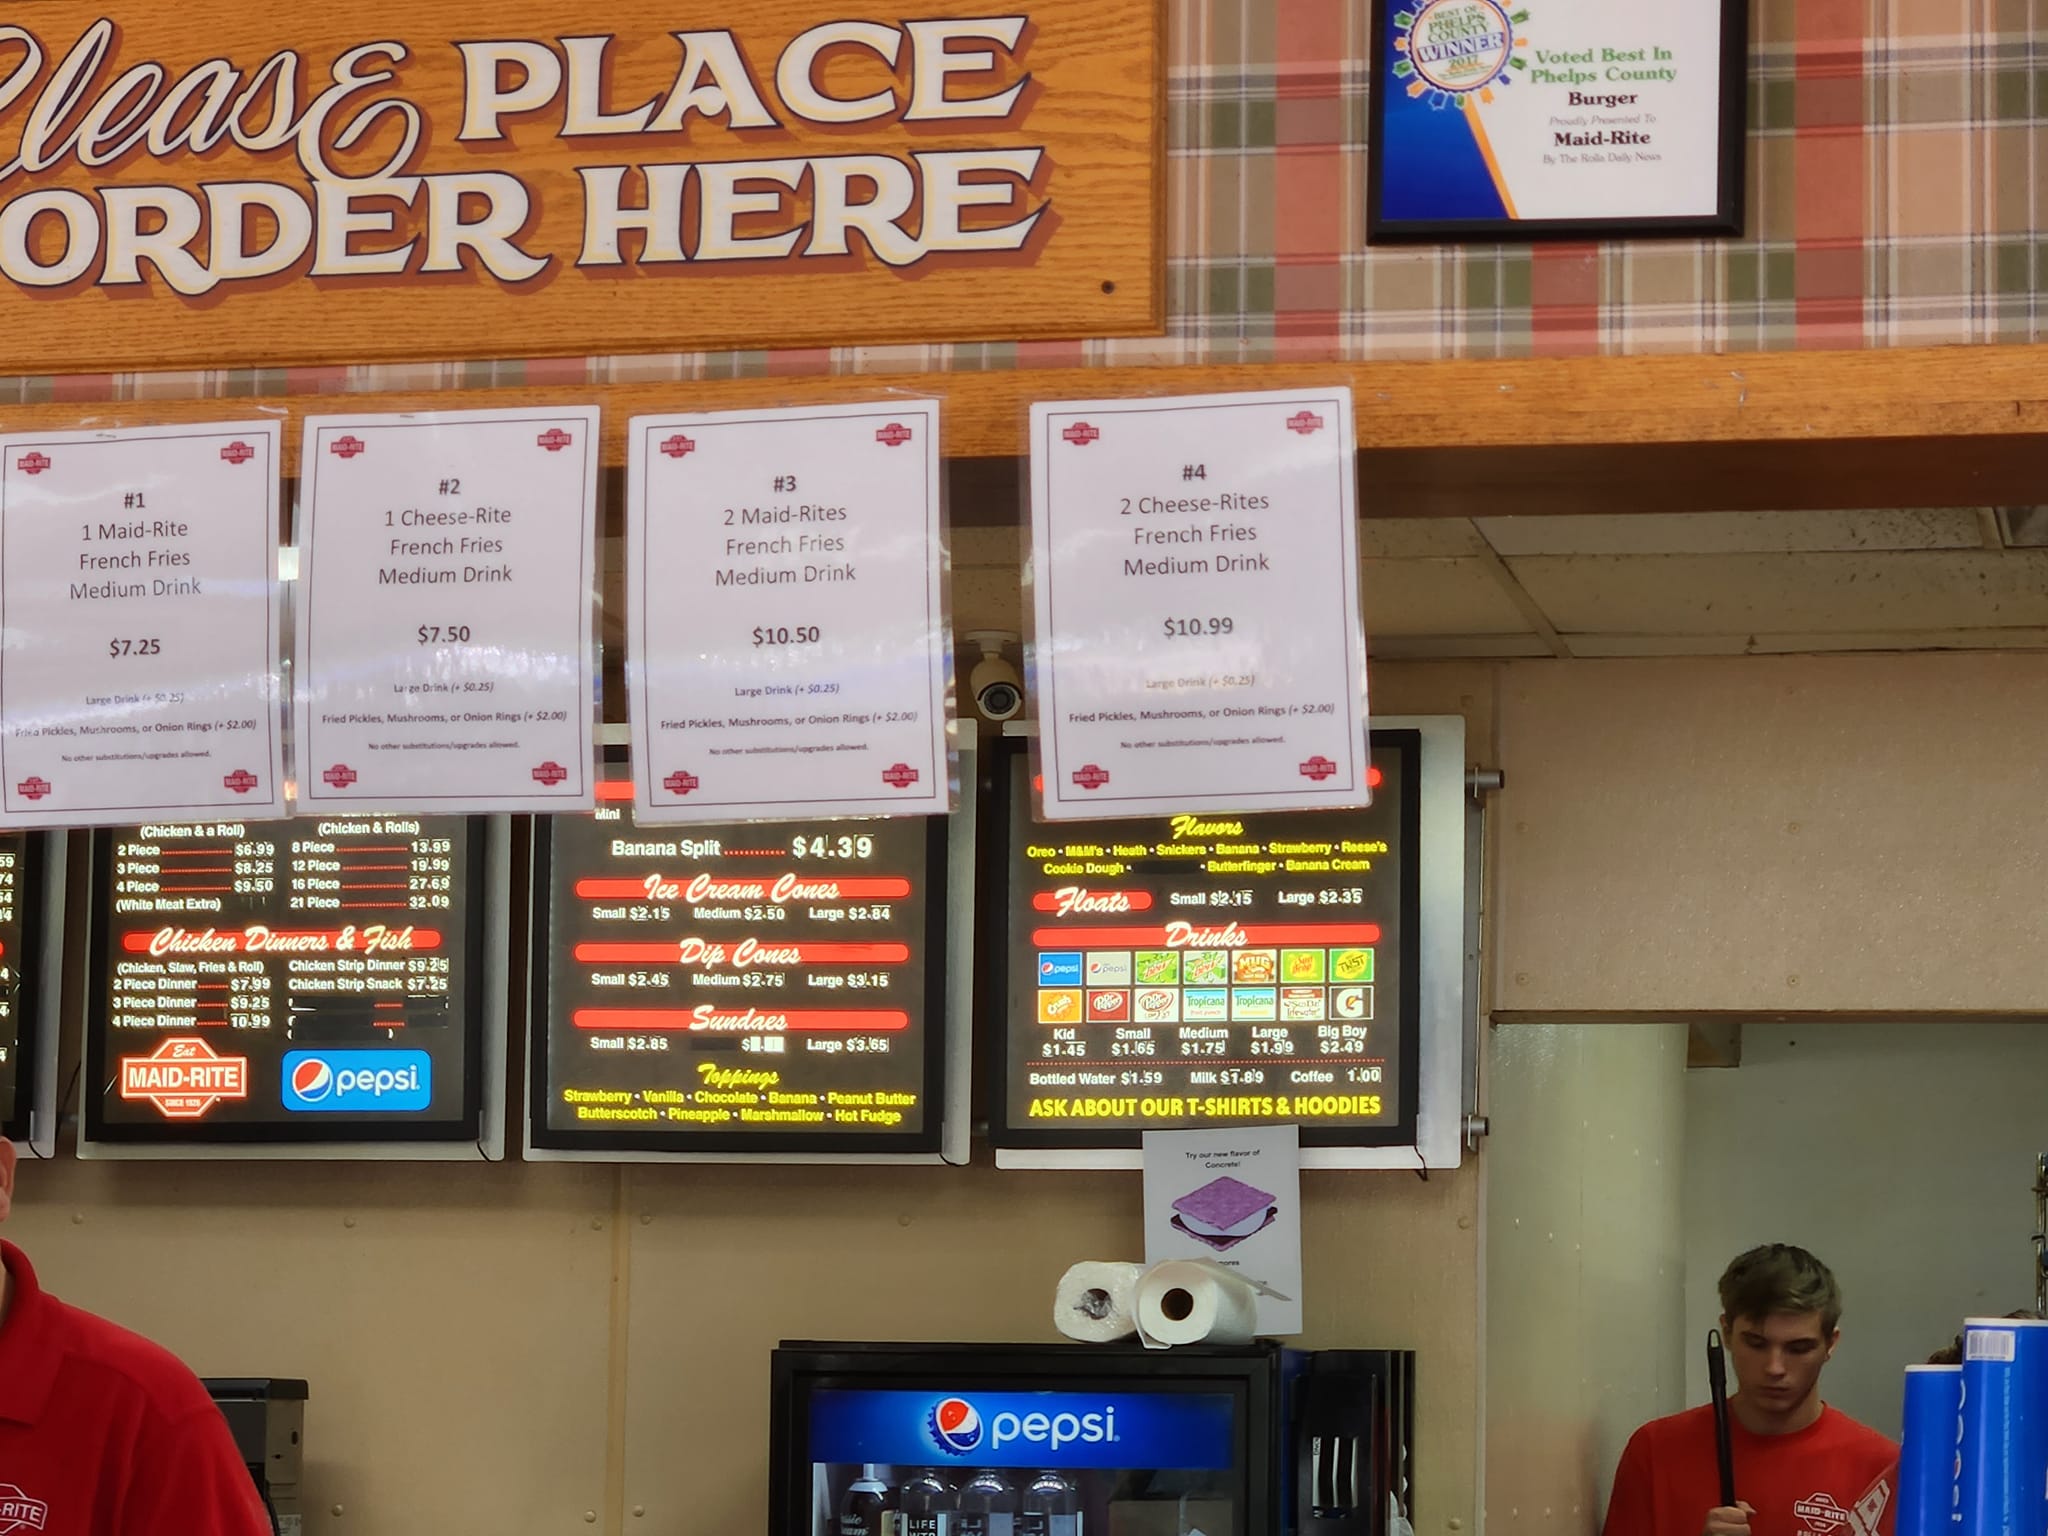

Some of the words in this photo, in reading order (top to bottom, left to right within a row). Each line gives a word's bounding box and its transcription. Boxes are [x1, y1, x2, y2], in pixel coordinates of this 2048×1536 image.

[1428, 13, 1486, 32] PHELPS
[1428, 25, 1487, 43] COUNTY
[1419, 32, 1505, 62] WINNER
[1535, 48, 1594, 64] Voted
[1601, 47, 1646, 62] Best
[1653, 46, 1673, 61] In
[1449, 54, 1479, 68] 2017
[453, 15, 1031, 141] PLACE
[1531, 68, 1597, 85] Phelps
[1605, 66, 1677, 82] County
[1568, 91, 1638, 108] Burger
[1549, 115, 1587, 126] Proudly
[1591, 114, 1640, 125] Presented
[1645, 113, 1656, 124] To
[1554, 130, 1651, 147] Maid-Rite
[0, 172, 552, 296] ORDER
[575, 146, 1052, 267] HERE
[1182, 464, 1207, 481] #4
[438, 478, 461, 496] #2
[774, 475, 797, 492] #3
[123, 492, 146, 509] #1
[1120, 498, 1131, 515] 2
[1138, 493, 1270, 515] Cheese-Rites
[384, 510, 394, 527] 1
[401, 506, 512, 527] Cheese-Rite
[723, 509, 734, 526] 2
[741, 503, 847, 525] Maid-Rites
[82, 524, 91, 541] 1
[99, 520, 188, 541] Maid-Rite
[1134, 524, 1202, 545] French
[1210, 523, 1257, 542] Fries
[390, 537, 453, 556] French
[460, 536, 503, 553] Fries
[726, 536, 792, 556] French
[799, 534, 845, 552] Fries
[80, 551, 141, 570] French
[148, 549, 190, 567] Fries
[1124, 556, 1208, 576] Medium
[1216, 553, 1270, 573] Drink
[378, 566, 456, 585] Medium
[463, 564, 512, 583] Drink
[715, 566, 796, 586] Medium
[804, 563, 856, 583] Drink
[70, 580, 146, 600] Medium
[153, 577, 201, 596] Drink
[418, 624, 470, 646] $7.50
[752, 625, 820, 648] $10.50
[1163, 616, 1233, 640] $10.99
[109, 637, 161, 659] $7.25
[734, 686, 762, 697] Large
[765, 685, 792, 696] Drink
[807, 682, 840, 695] $0.25)
[661, 719, 685, 730] Fried
[688, 718, 725, 730] Pickles,
[728, 716, 792, 728] Mushrooms,
[795, 717, 806, 725] or
[808, 714, 839, 725] Onion
[842, 713, 870, 726] Rings
[885, 711, 918, 724] $2.00)
[1073, 772, 1108, 783] MAID-RITE
[140, 825, 192, 839] (Chicken
[194, 825, 205, 836] &
[206, 827, 215, 836] a
[217, 824, 245, 838] Roll)
[318, 822, 370, 837] (Chicken
[373, 821, 383, 833] &
[385, 821, 420, 835] Rolls)
[1170, 815, 1244, 840] Flavors
[118, 845, 126, 856] 2
[128, 844, 160, 856] Piece
[235, 842, 275, 856] $6.99
[292, 842, 300, 853] 8
[302, 841, 335, 852] Piece
[411, 840, 451, 853] 13.99
[612, 840, 677, 857] Banana
[681, 839, 721, 858] Split
[792, 836, 873, 858] $4.39
[644, 874, 679, 900] Ice
[686, 873, 764, 903] Cream
[771, 873, 840, 903] Cones
[1170, 892, 1205, 905] Small
[1210, 890, 1253, 906] $2.15
[1278, 891, 1315, 906] Large
[1319, 888, 1363, 905] $2.35
[1054, 886, 1129, 917] Floats
[592, 907, 626, 920] Small
[630, 906, 670, 921] $2.15
[694, 906, 741, 920] Medium
[744, 906, 785, 920] $2.50
[809, 907, 844, 921] Large
[849, 906, 891, 920] $2.84
[150, 926, 236, 957] Chicken
[244, 925, 329, 952] Dinners
[335, 925, 356, 951] &
[363, 924, 414, 955] Fish
[1164, 921, 1248, 947] Drinks
[679, 938, 724, 969] Dip
[732, 938, 801, 967] Cones
[1236, 994, 1274, 1008] Tropicana
[689, 1005, 788, 1031] Sundaes
[1054, 1028, 1075, 1040] Kid
[1116, 1028, 1151, 1040] Small
[1179, 1027, 1229, 1040] Medium
[1252, 1026, 1288, 1041] Large
[1318, 1025, 1339, 1040] Big
[1343, 1025, 1367, 1039] Boy
[172, 1044, 196, 1058] Eat
[1043, 1042, 1086, 1057] $1.45
[1111, 1041, 1155, 1056] $1.65
[1181, 1041, 1225, 1056] $1.75
[1320, 1039, 1364, 1054] $2.49
[129, 1067, 239, 1088] MAID-RITE
[336, 1064, 418, 1096] pepsi
[698, 1063, 779, 1088] Toppings
[1030, 1072, 1076, 1085] Bottled
[1078, 1072, 1115, 1084] Water
[1120, 1070, 1163, 1085] $1.59
[1190, 1070, 1217, 1083] Milk
[1290, 1071, 1334, 1083] Coffee
[564, 1090, 631, 1105] Strawberry
[643, 1090, 684, 1104] Vanilla
[695, 1091, 759, 1104] Chocolate
[768, 1092, 817, 1105] Banana
[828, 1092, 873, 1105] Peanut
[875, 1092, 916, 1106] Butter
[1028, 1098, 1067, 1117] ASK
[1071, 1098, 1138, 1116] ABOUT
[1141, 1098, 1183, 1116] OUR
[1187, 1097, 1272, 1116] T-SHIRTS
[1276, 1097, 1291, 1115] &
[1294, 1096, 1381, 1115] HOODIES
[1186, 1152, 1197, 1160] Try
[1230, 1150, 1250, 1158] flavor
[992, 1405, 1115, 1450] pepsi
[1797, 1504, 1846, 1521] MAID-RITE
[909, 1519, 936, 1530] LIFE
